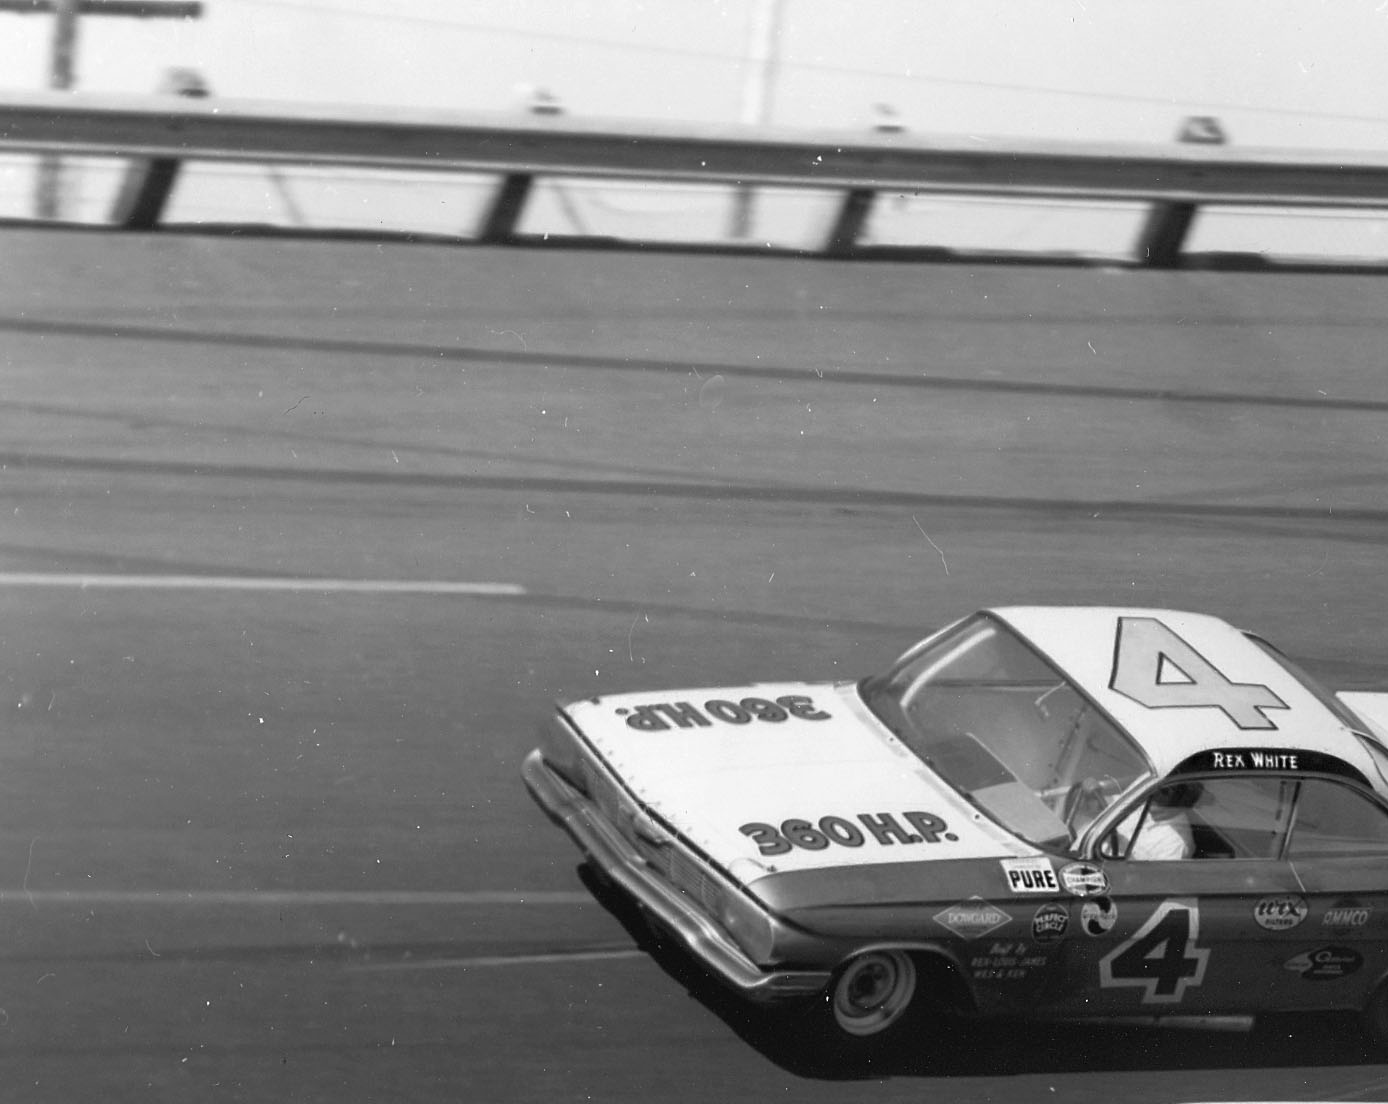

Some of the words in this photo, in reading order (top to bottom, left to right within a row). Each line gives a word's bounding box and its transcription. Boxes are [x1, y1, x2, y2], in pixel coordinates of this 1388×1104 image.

[1108, 616, 1291, 731] 4
[1213, 751, 1245, 768] REX
[1250, 751, 1298, 769] WHITE
[1008, 869, 1057, 888] PURE
[947, 911, 1002, 925] DOWGARD
[1098, 897, 1211, 1004] 4
